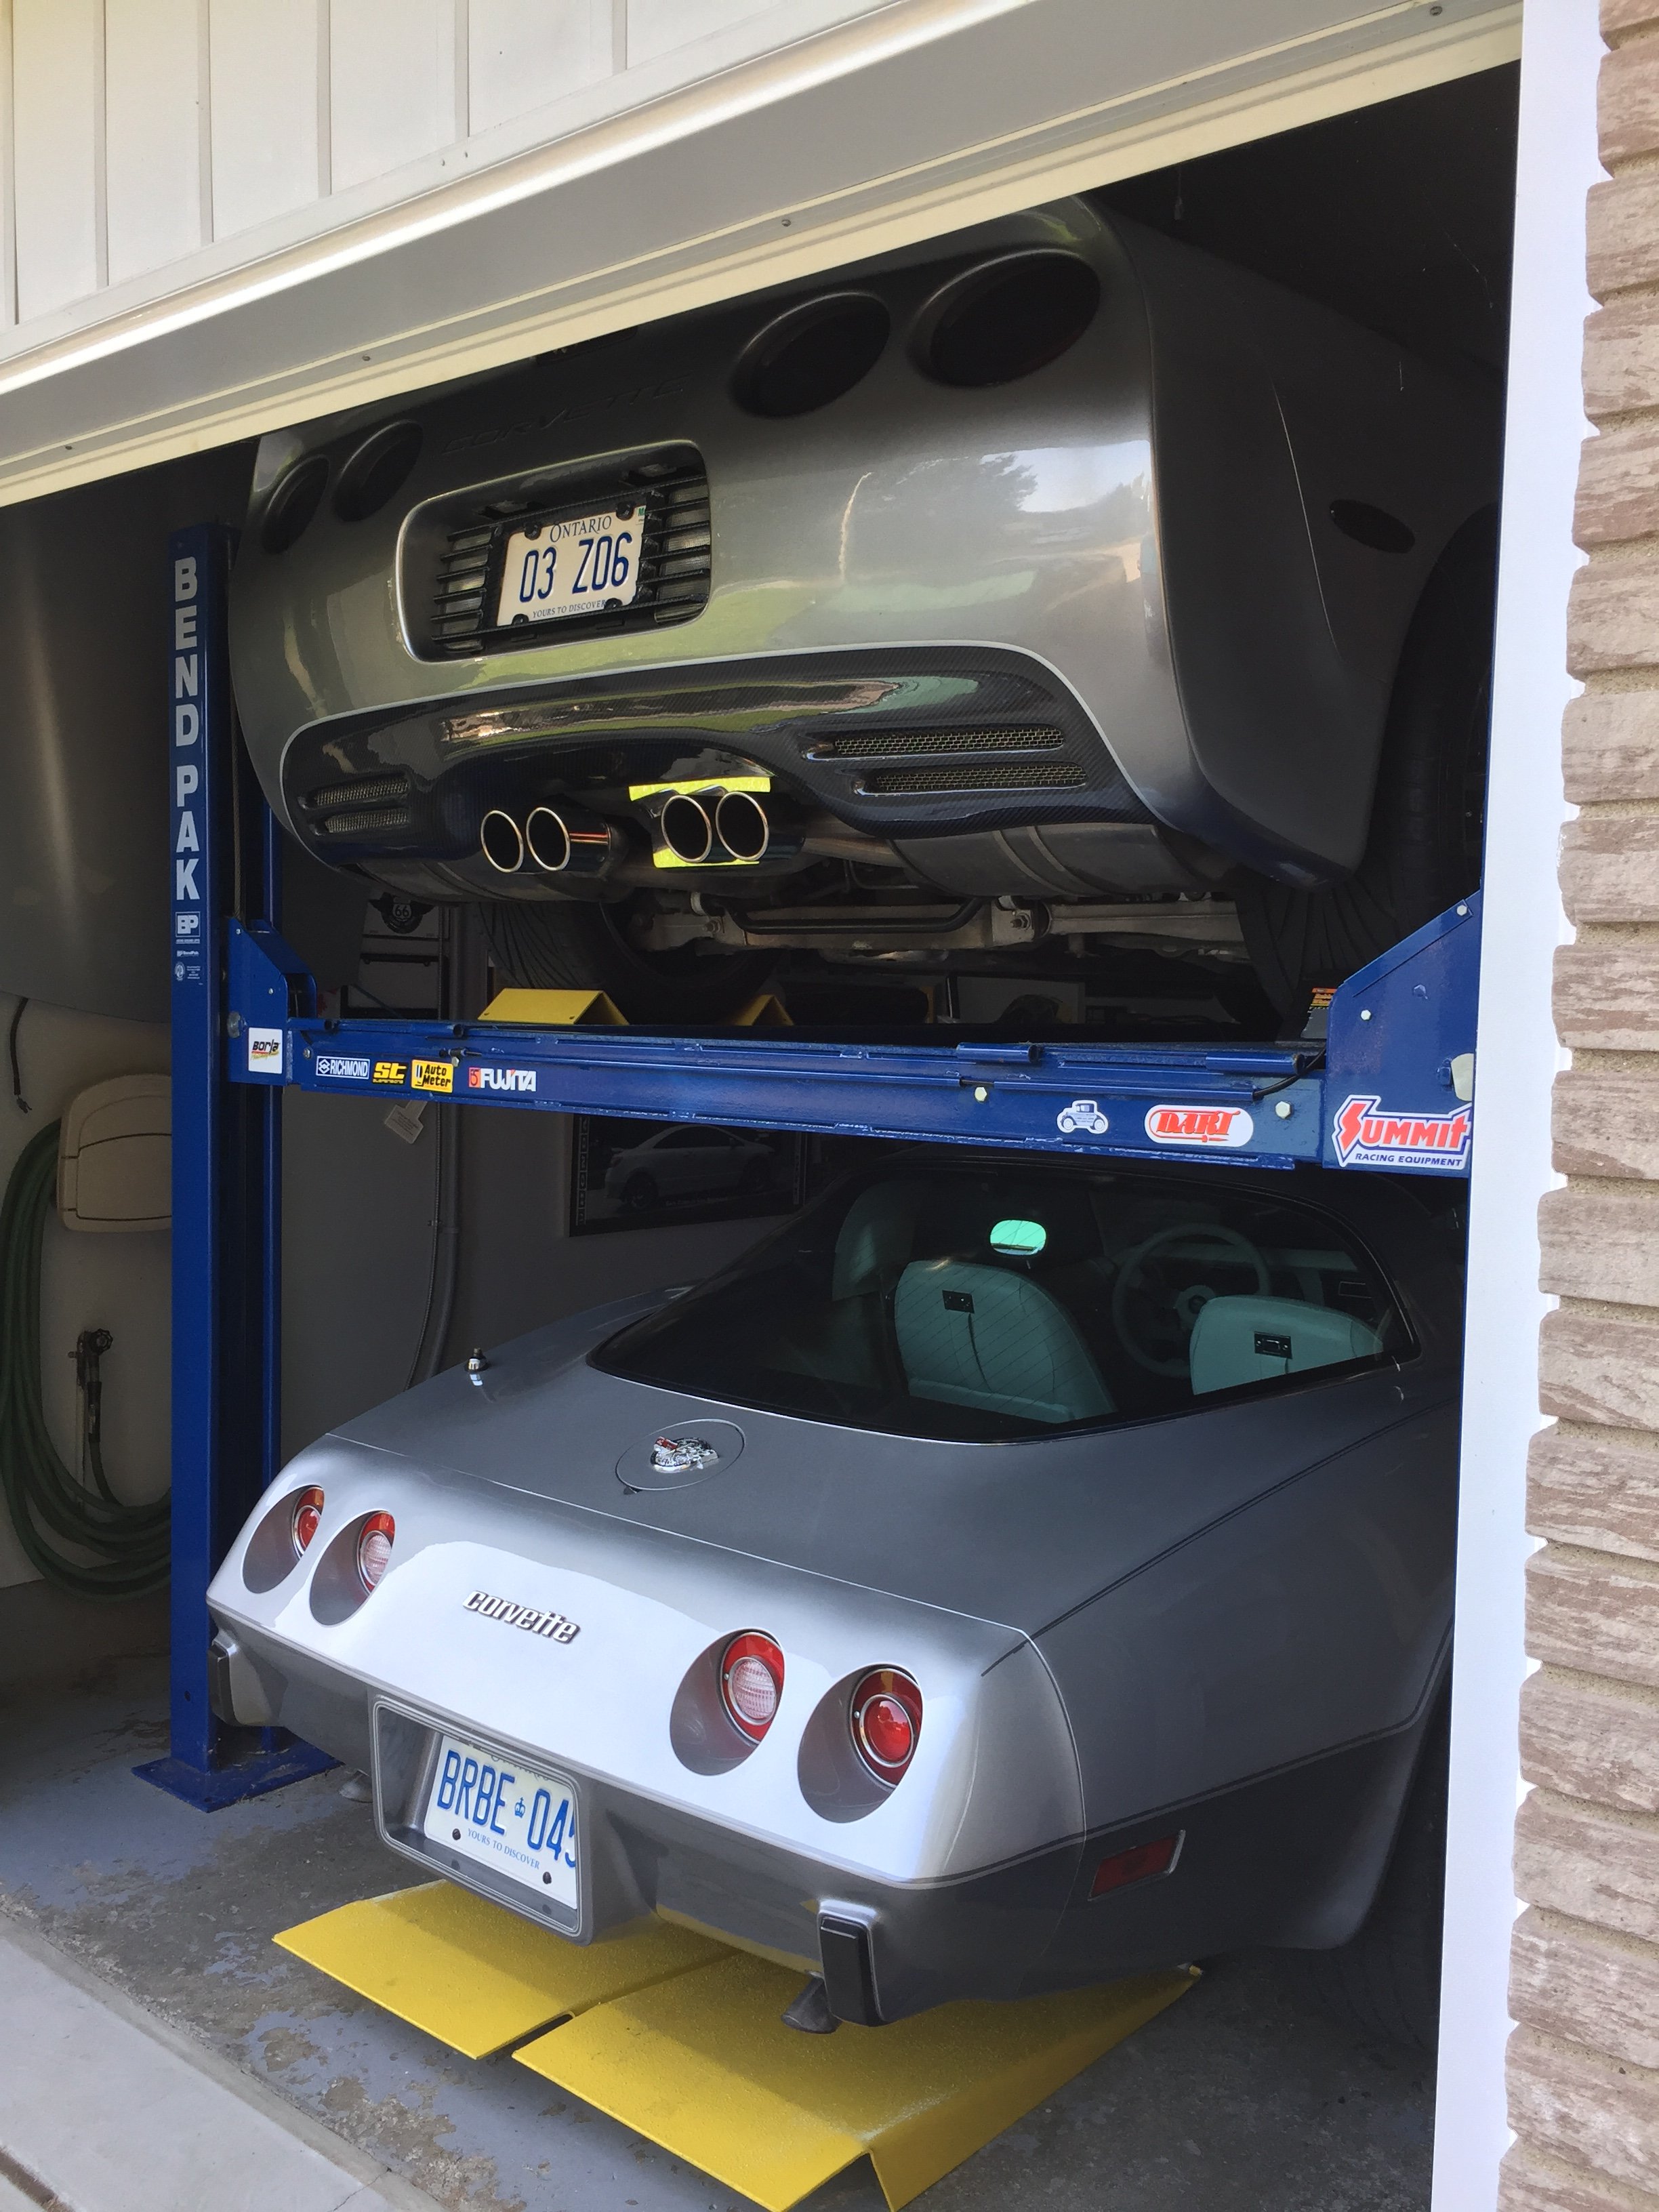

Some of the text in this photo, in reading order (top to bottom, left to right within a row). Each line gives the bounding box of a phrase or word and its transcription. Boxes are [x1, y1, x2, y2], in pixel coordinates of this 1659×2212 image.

[550, 516, 612, 542] ONTARIO
[519, 546, 557, 602] 03
[533, 600, 606, 619] YOURS TO DISCOVER
[175, 556, 200, 901] BEND PAK
[394, 905, 409, 917] 66
[178, 915, 199, 934] BP
[330, 1059, 368, 1077] RICHMOND
[425, 1064, 447, 1076] Auto
[423, 1075, 451, 1087] Meter
[1355, 1153, 1462, 1166] RACING EQUIPMENT
[462, 1590, 581, 1644] corvette
[436, 1749, 515, 1835] BRBE
[468, 1828, 540, 1870] YOURS TO DISCOVER
